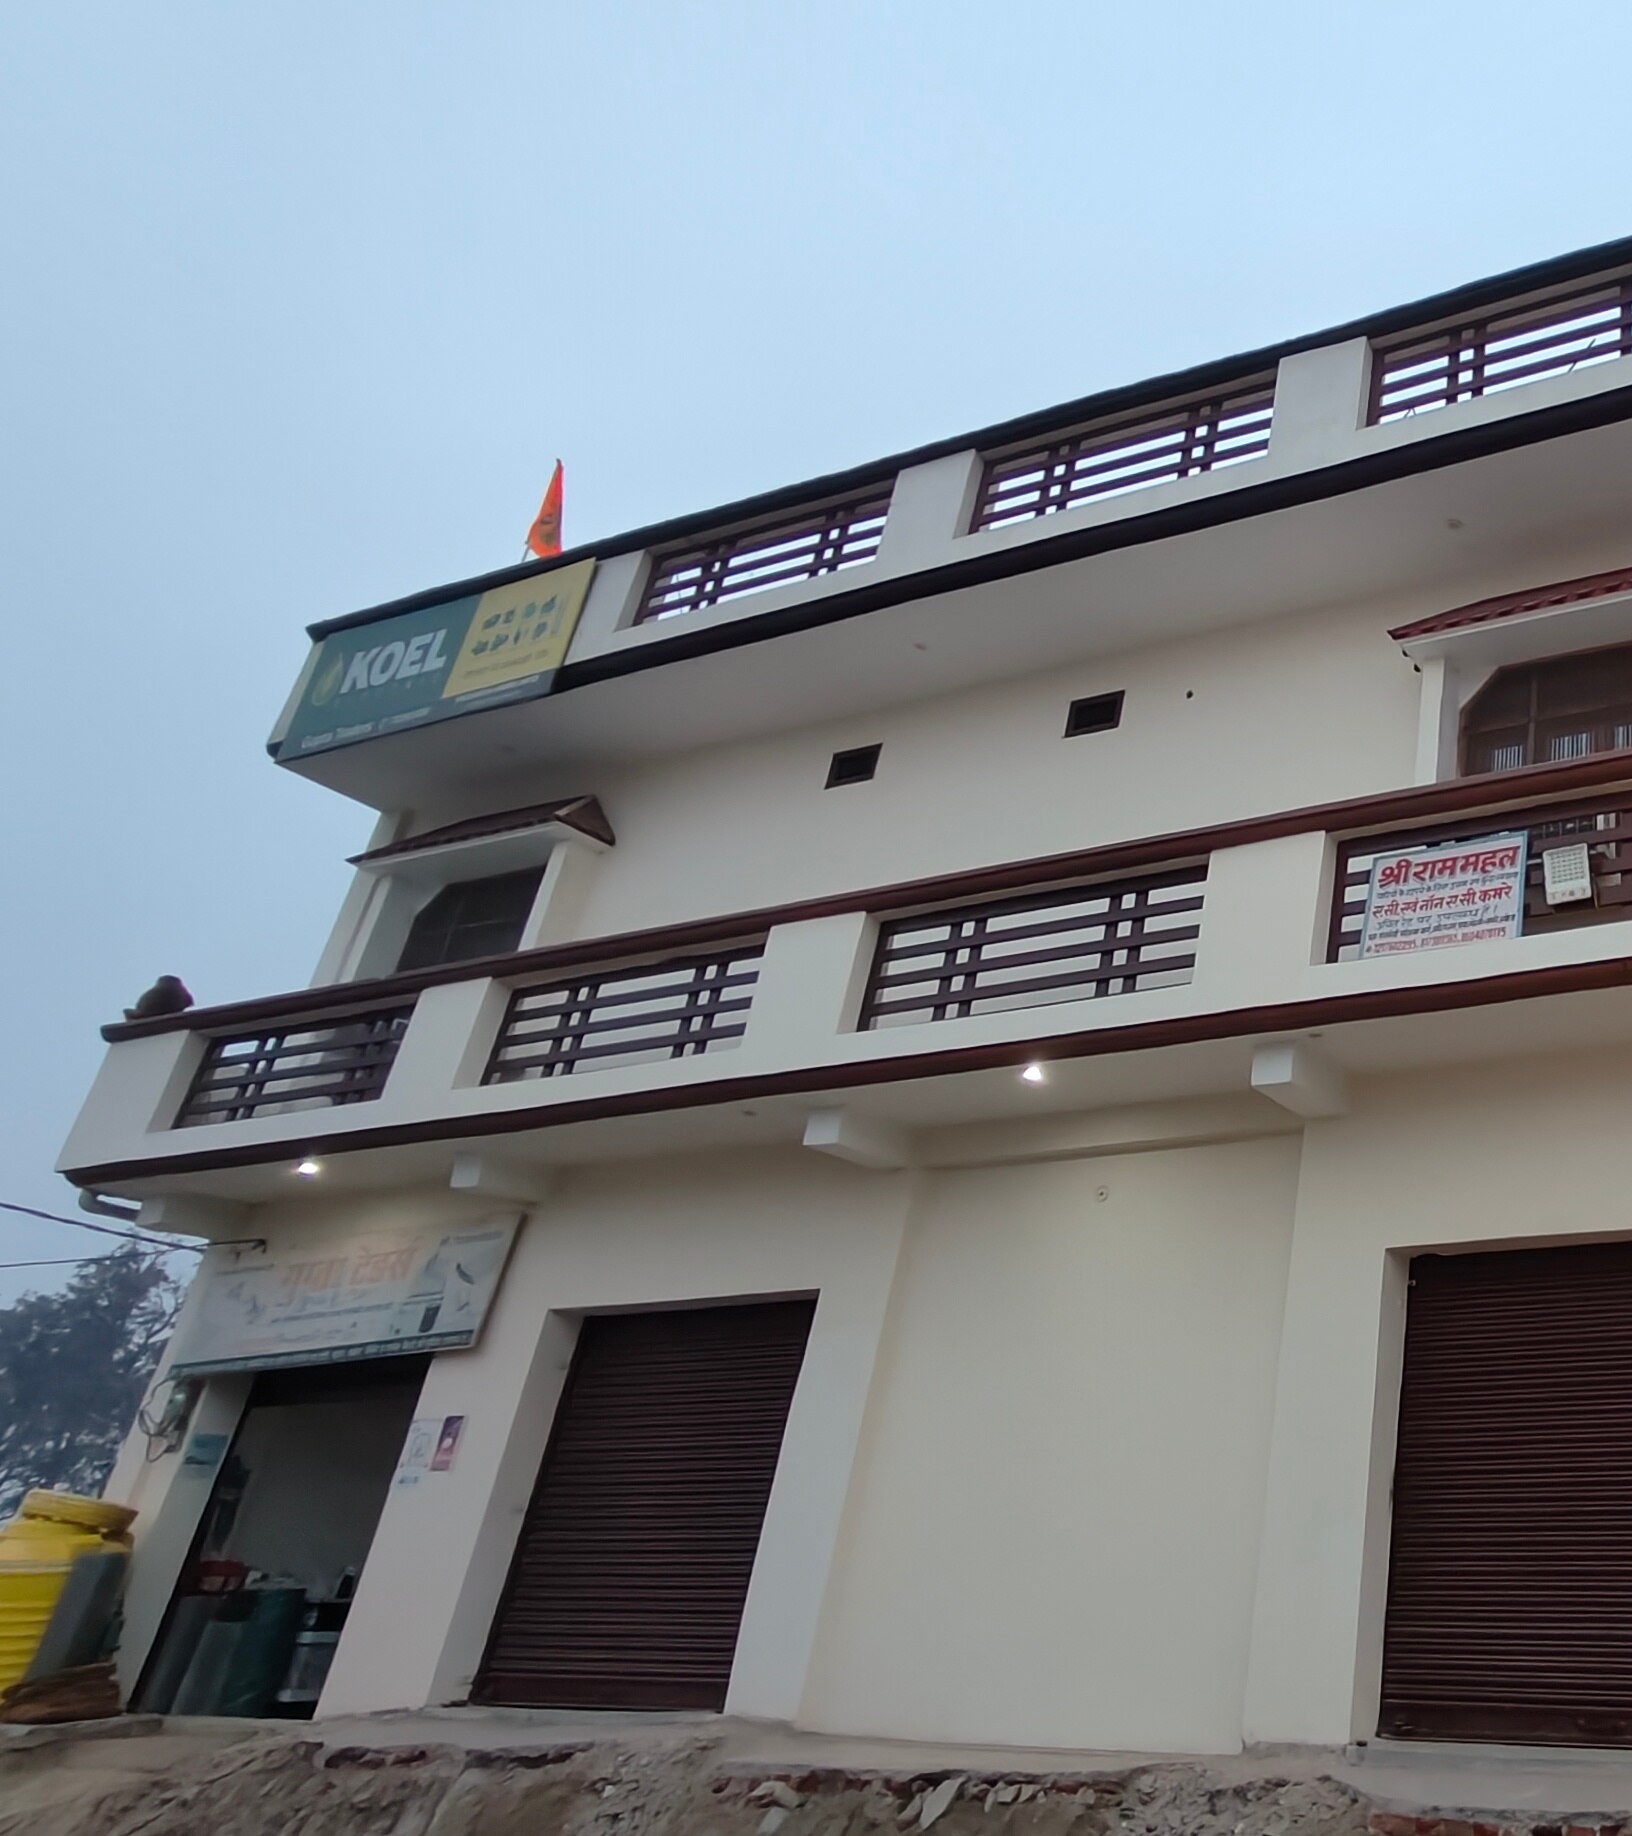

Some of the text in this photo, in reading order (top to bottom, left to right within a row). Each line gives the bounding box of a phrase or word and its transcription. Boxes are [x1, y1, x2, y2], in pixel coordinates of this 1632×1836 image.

[340, 629, 447, 694] KOEL
[1378, 859, 1412, 888] श्री
[1413, 856, 1459, 882] राम
[1460, 846, 1521, 873] महल
[1479, 882, 1512, 903] कमरे
